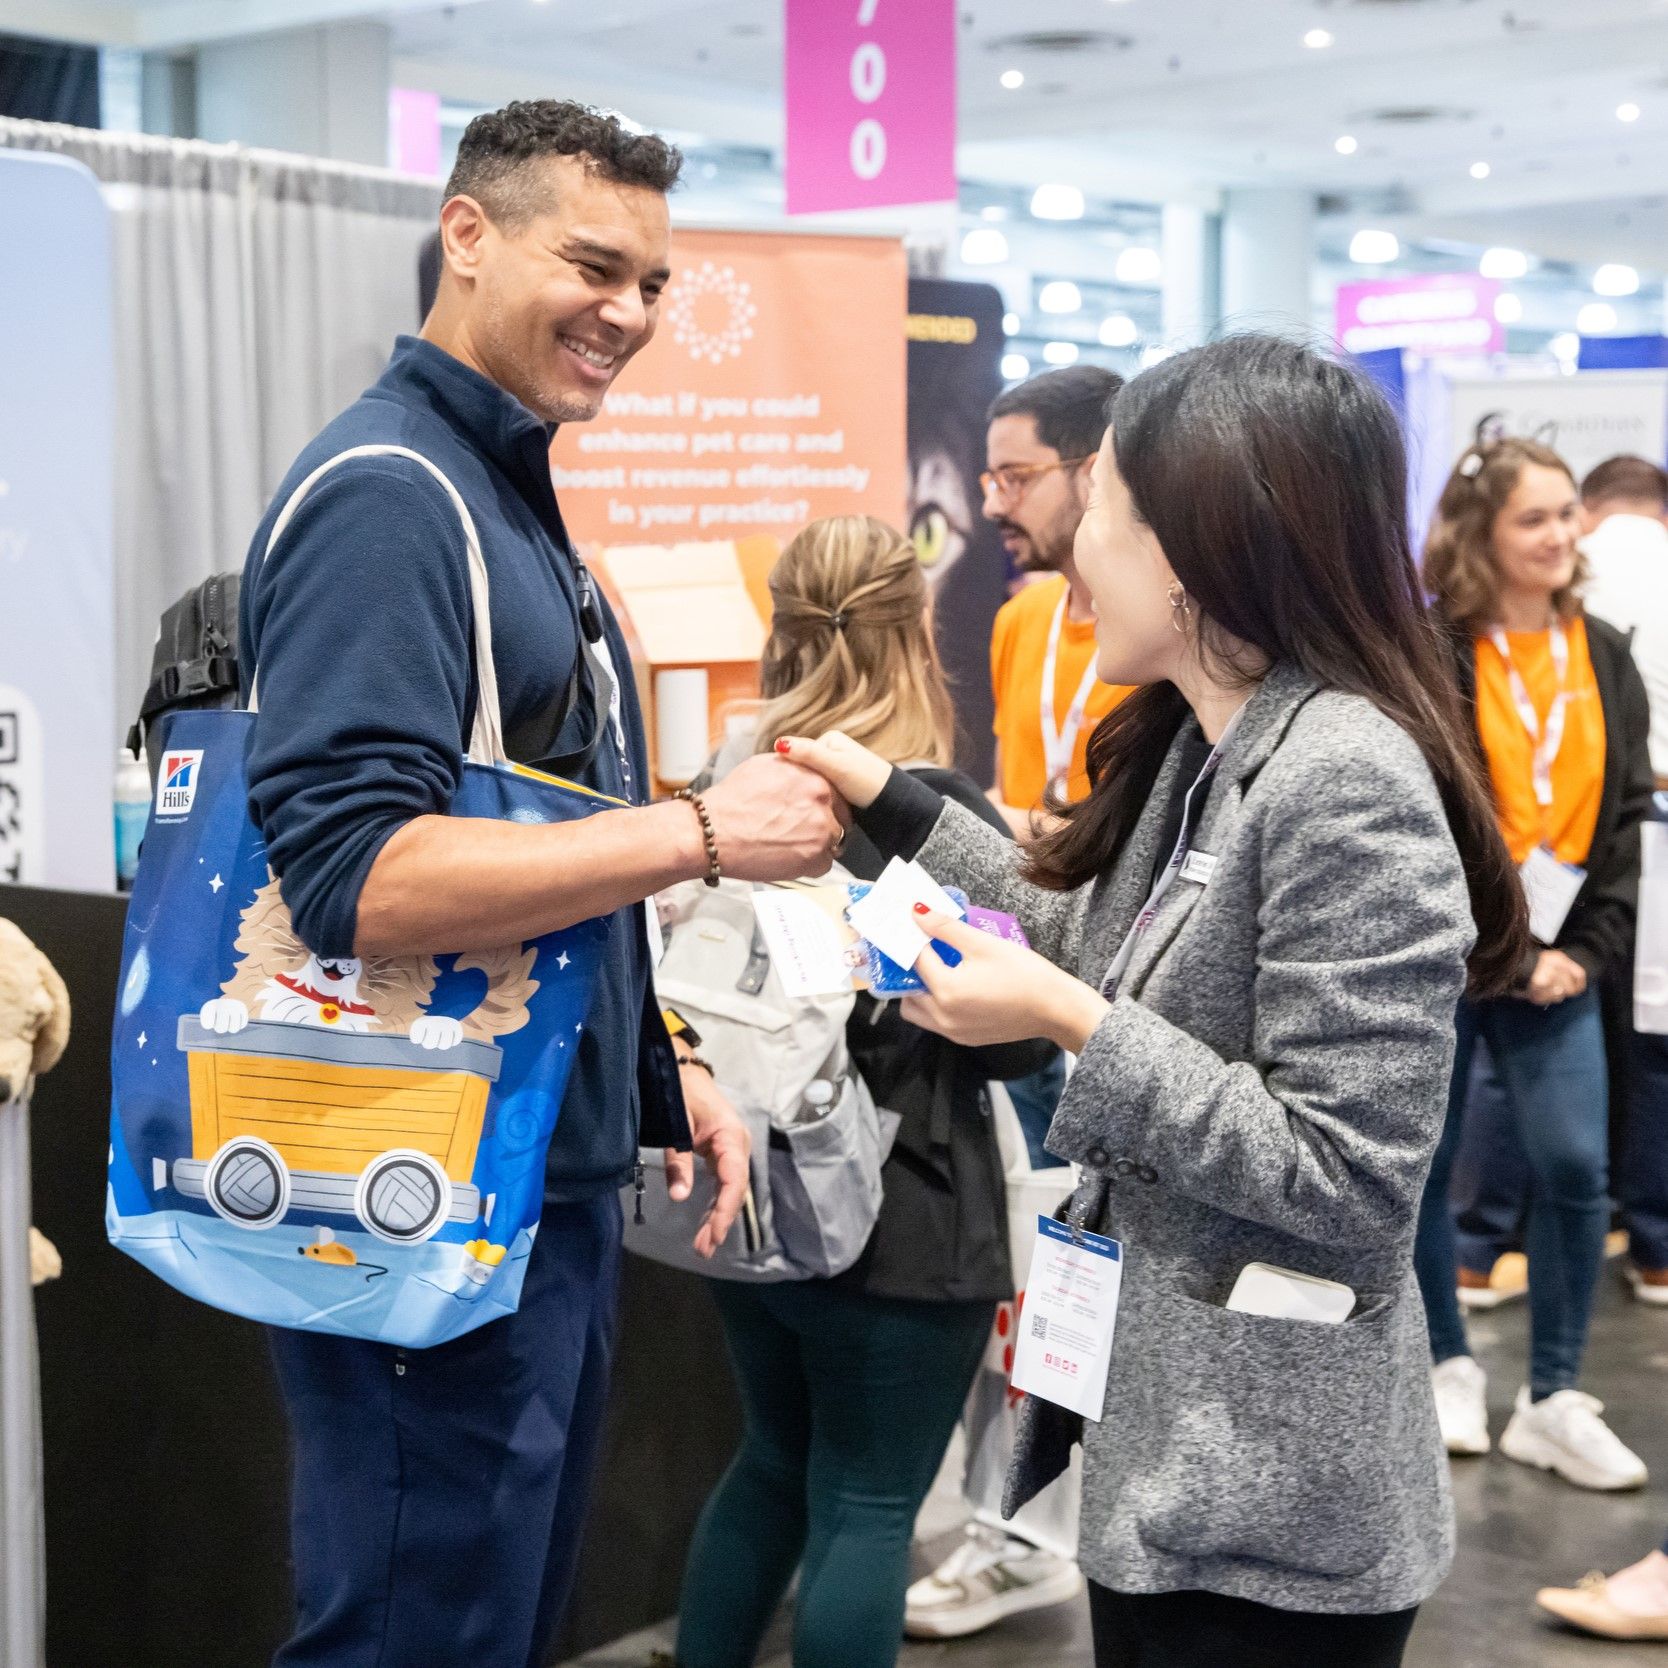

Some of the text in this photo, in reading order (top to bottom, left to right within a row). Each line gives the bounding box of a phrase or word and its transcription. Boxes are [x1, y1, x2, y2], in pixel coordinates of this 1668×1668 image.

[604, 391, 820, 421] What if you could
[578, 428, 844, 457] enhance pet care and
[551, 463, 870, 492] boost revenue effortlessly
[608, 497, 809, 528] in your practice?
[163, 791, 191, 807] Hill's
